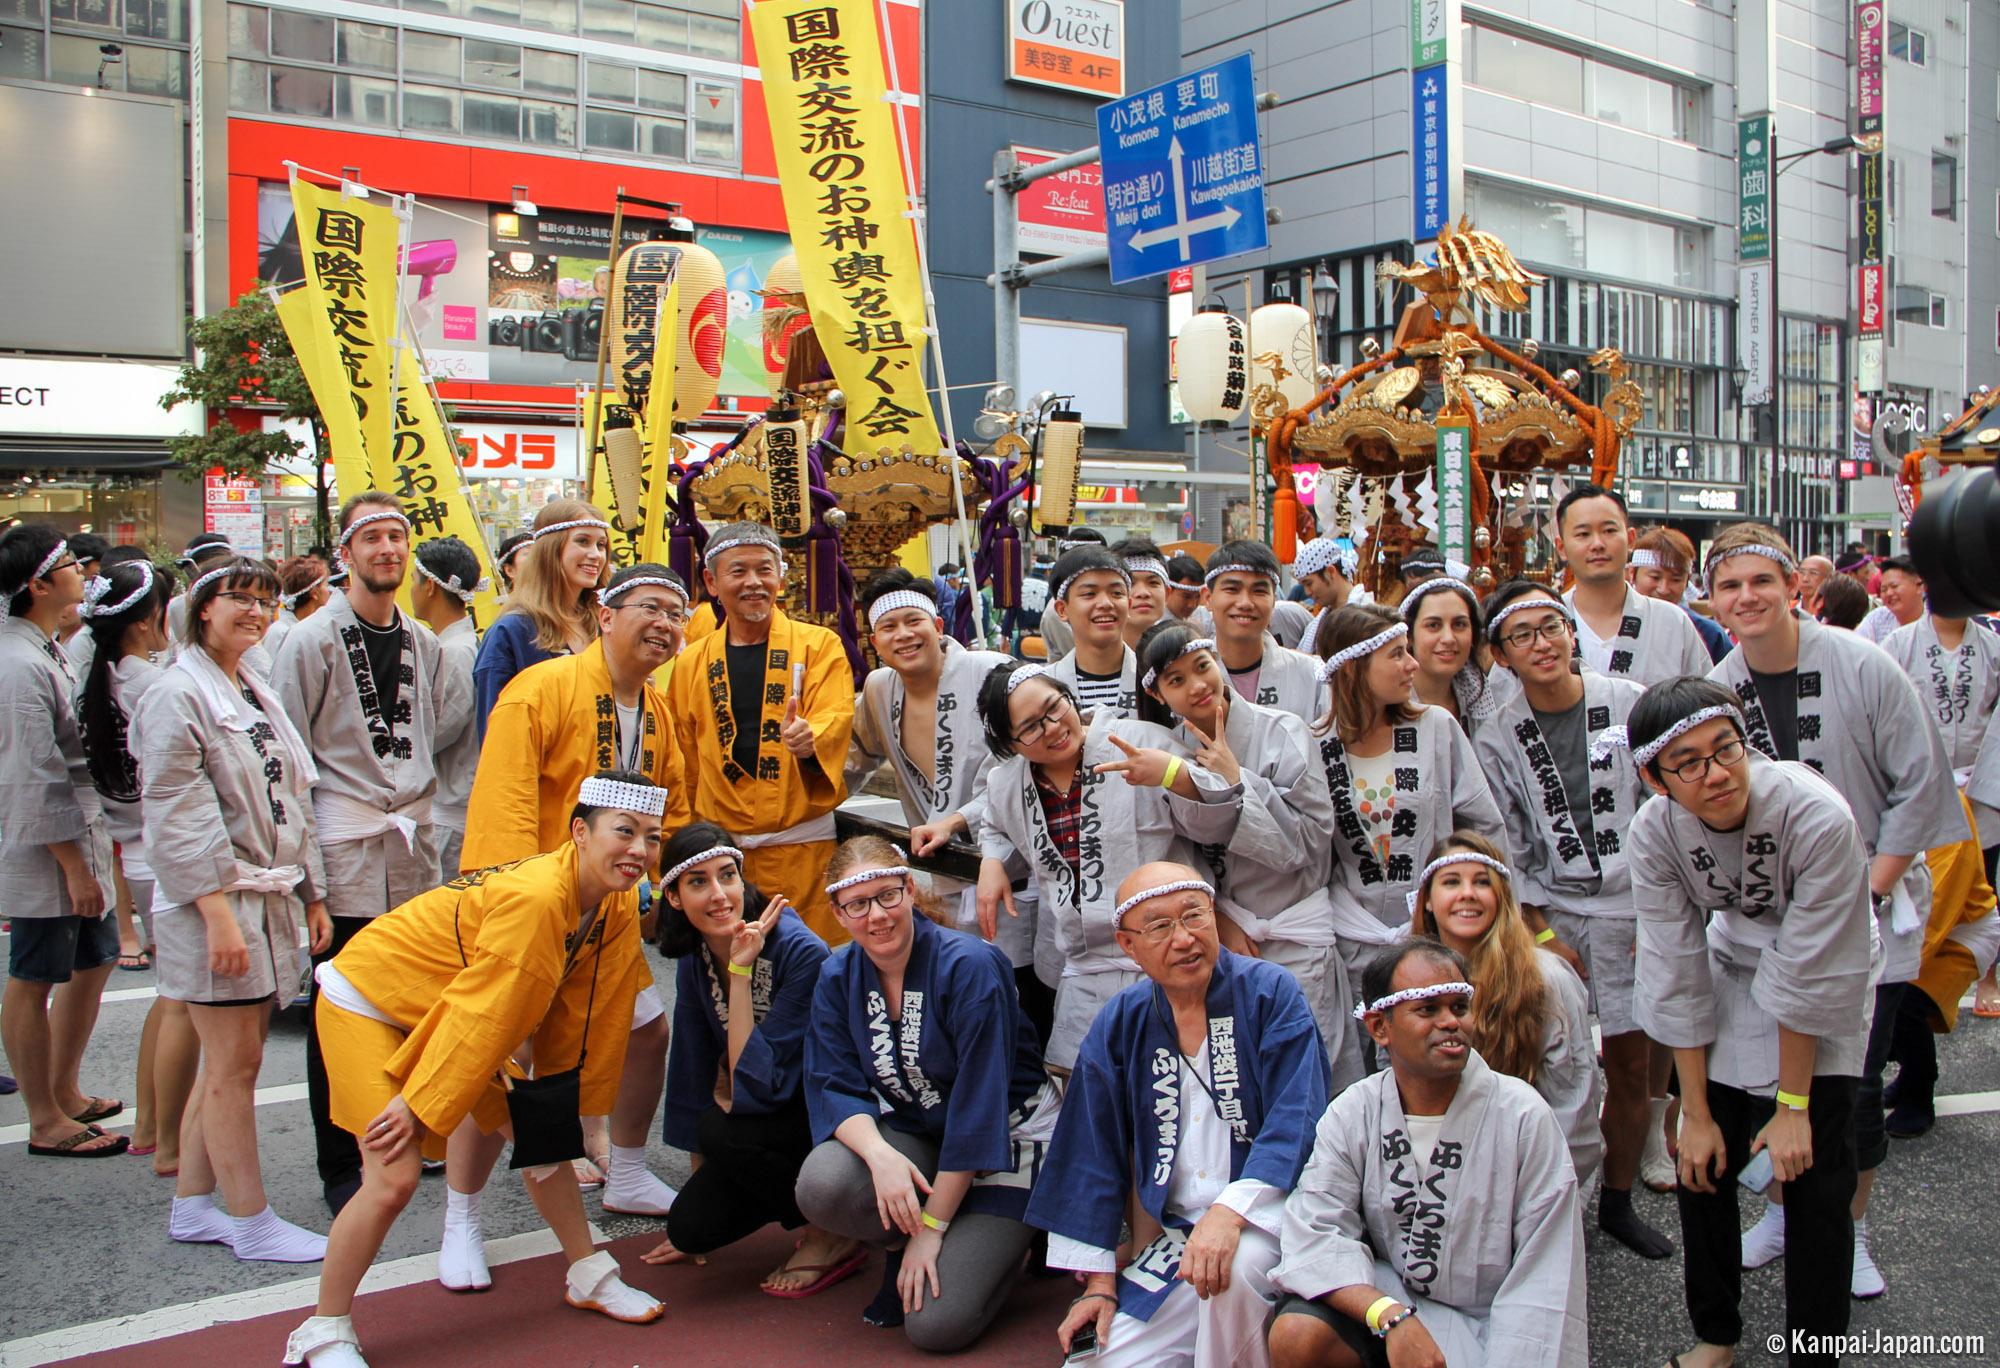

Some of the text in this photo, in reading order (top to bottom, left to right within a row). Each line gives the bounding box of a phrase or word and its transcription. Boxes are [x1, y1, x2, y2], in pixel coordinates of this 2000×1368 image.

[1022, 0, 1114, 50] Ouest
[1025, 47, 1113, 79] 美容室 4F
[1110, 72, 1219, 133] 小茂根 要町
[1119, 102, 1230, 149] Komone Kanamecho
[1106, 171, 1164, 211] 明治通り
[1191, 174, 1261, 206] Kawagoekaido
[1192, 142, 1256, 187] 川越街道
[1423, 100, 1437, 229] 東京個別指導学院
[784, 7, 924, 438] 国際交流のお神輿を担ぐ会
[1116, 201, 1161, 227] Meiji dori
[1742, 170, 1766, 231] 歯科
[1750, 272, 1759, 385] PARTNER AGENT
[0, 387, 50, 406] ECT
[758, 649, 789, 780] 国際交流
[1387, 727, 1419, 882] 国際交流
[1152, 1048, 1181, 1186] ふくろまつり
